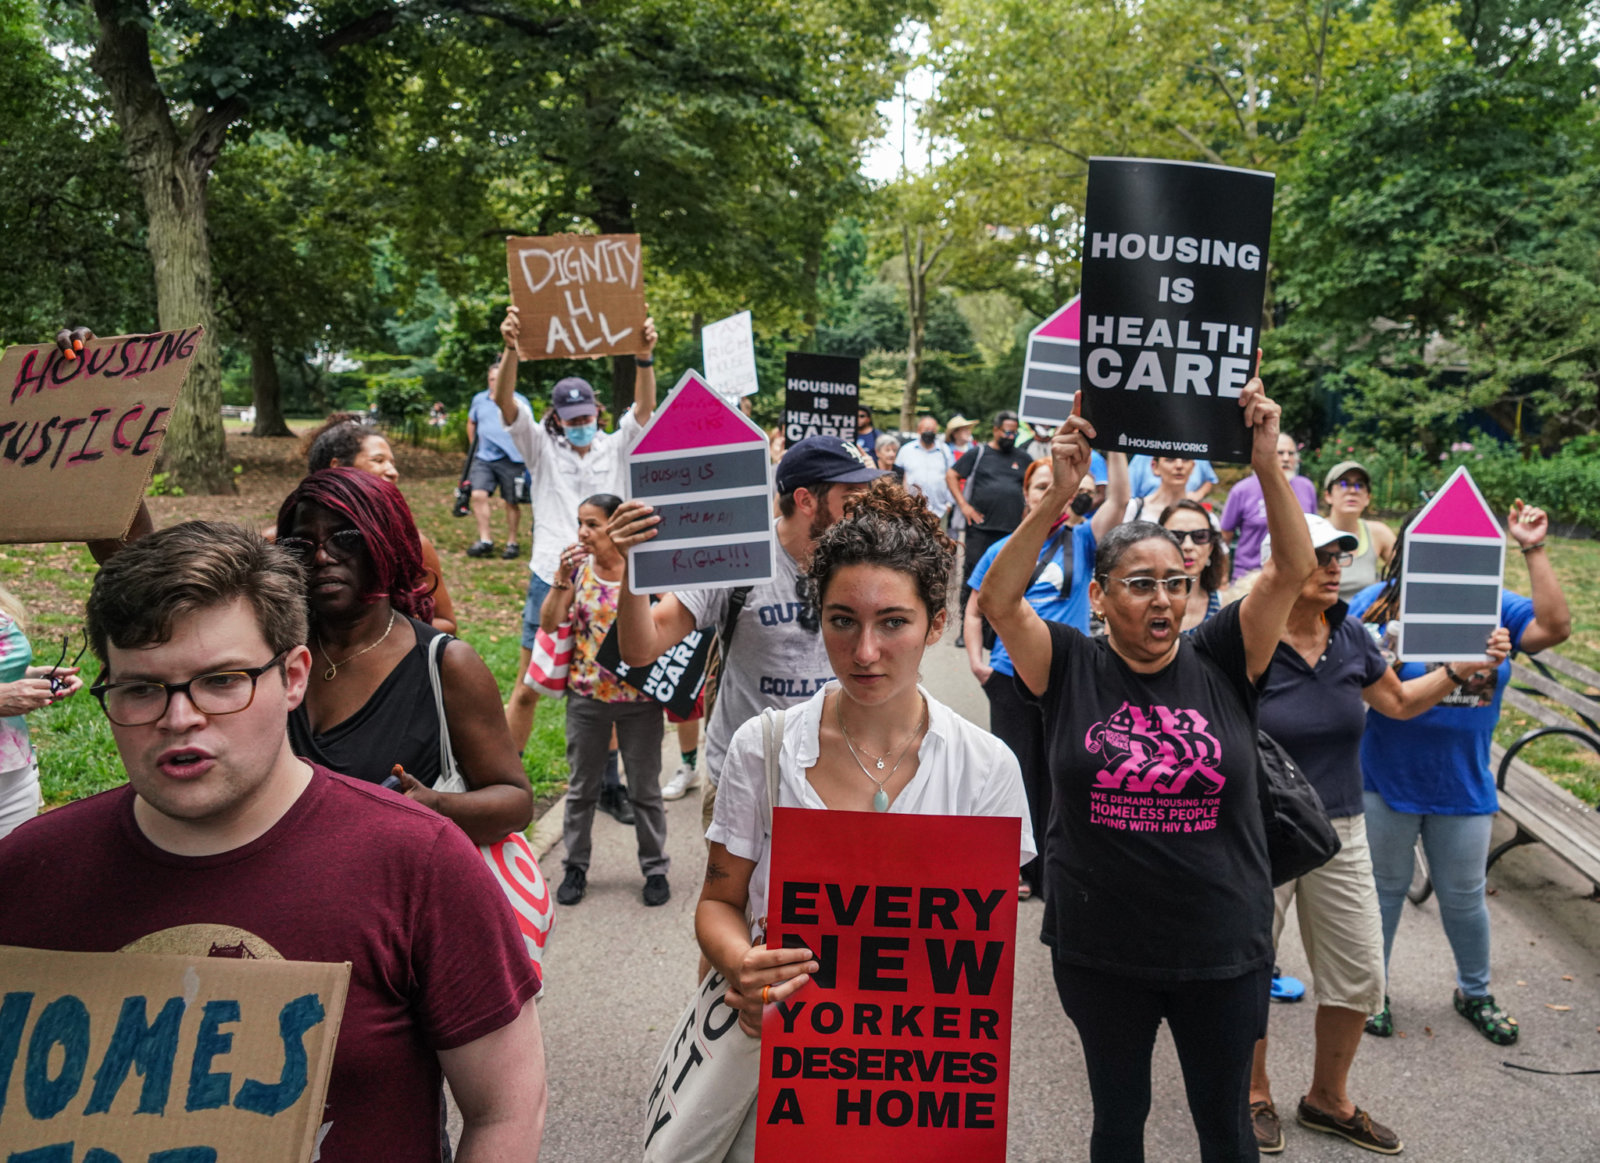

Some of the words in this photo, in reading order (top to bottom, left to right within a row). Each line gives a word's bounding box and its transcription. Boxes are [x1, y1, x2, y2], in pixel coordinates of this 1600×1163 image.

[519, 240, 641, 293] DIGNITY
[1091, 232, 1260, 271] HOUSING
[1158, 276, 1195, 304] IS
[546, 312, 633, 354] ALL
[1087, 314, 1253, 355] HEALTH
[11, 329, 198, 404] HOUSING
[1086, 348, 1250, 398] CARE
[787, 378, 857, 396] HOUSING
[813, 397, 829, 409] IS
[787, 410, 856, 427] HEALTH
[1128, 438, 1171, 450] HOUSING
[1172, 441, 1208, 453] WORKS
[655, 630, 703, 702] CARE
[1090, 791, 1107, 801] WE
[1110, 794, 1154, 806] DEMAND
[1156, 798, 1199, 808] HOUSING
[1202, 797, 1220, 806] FOR
[1091, 801, 1165, 820] HOMELESS
[1169, 807, 1219, 820] PEOPLE
[1090, 814, 1126, 830] LIVING
[1129, 820, 1159, 832] WITH
[1162, 822, 1181, 832] HIV
[1183, 823, 1192, 833] &
[1194, 819, 1217, 832] AIDS
[781, 881, 1007, 931] EVERY
[776, 1001, 999, 1040] YORKER
[772, 1046, 997, 1084] DESERVES
[767, 1088, 804, 1125] A
[835, 1089, 995, 1129] HOME
